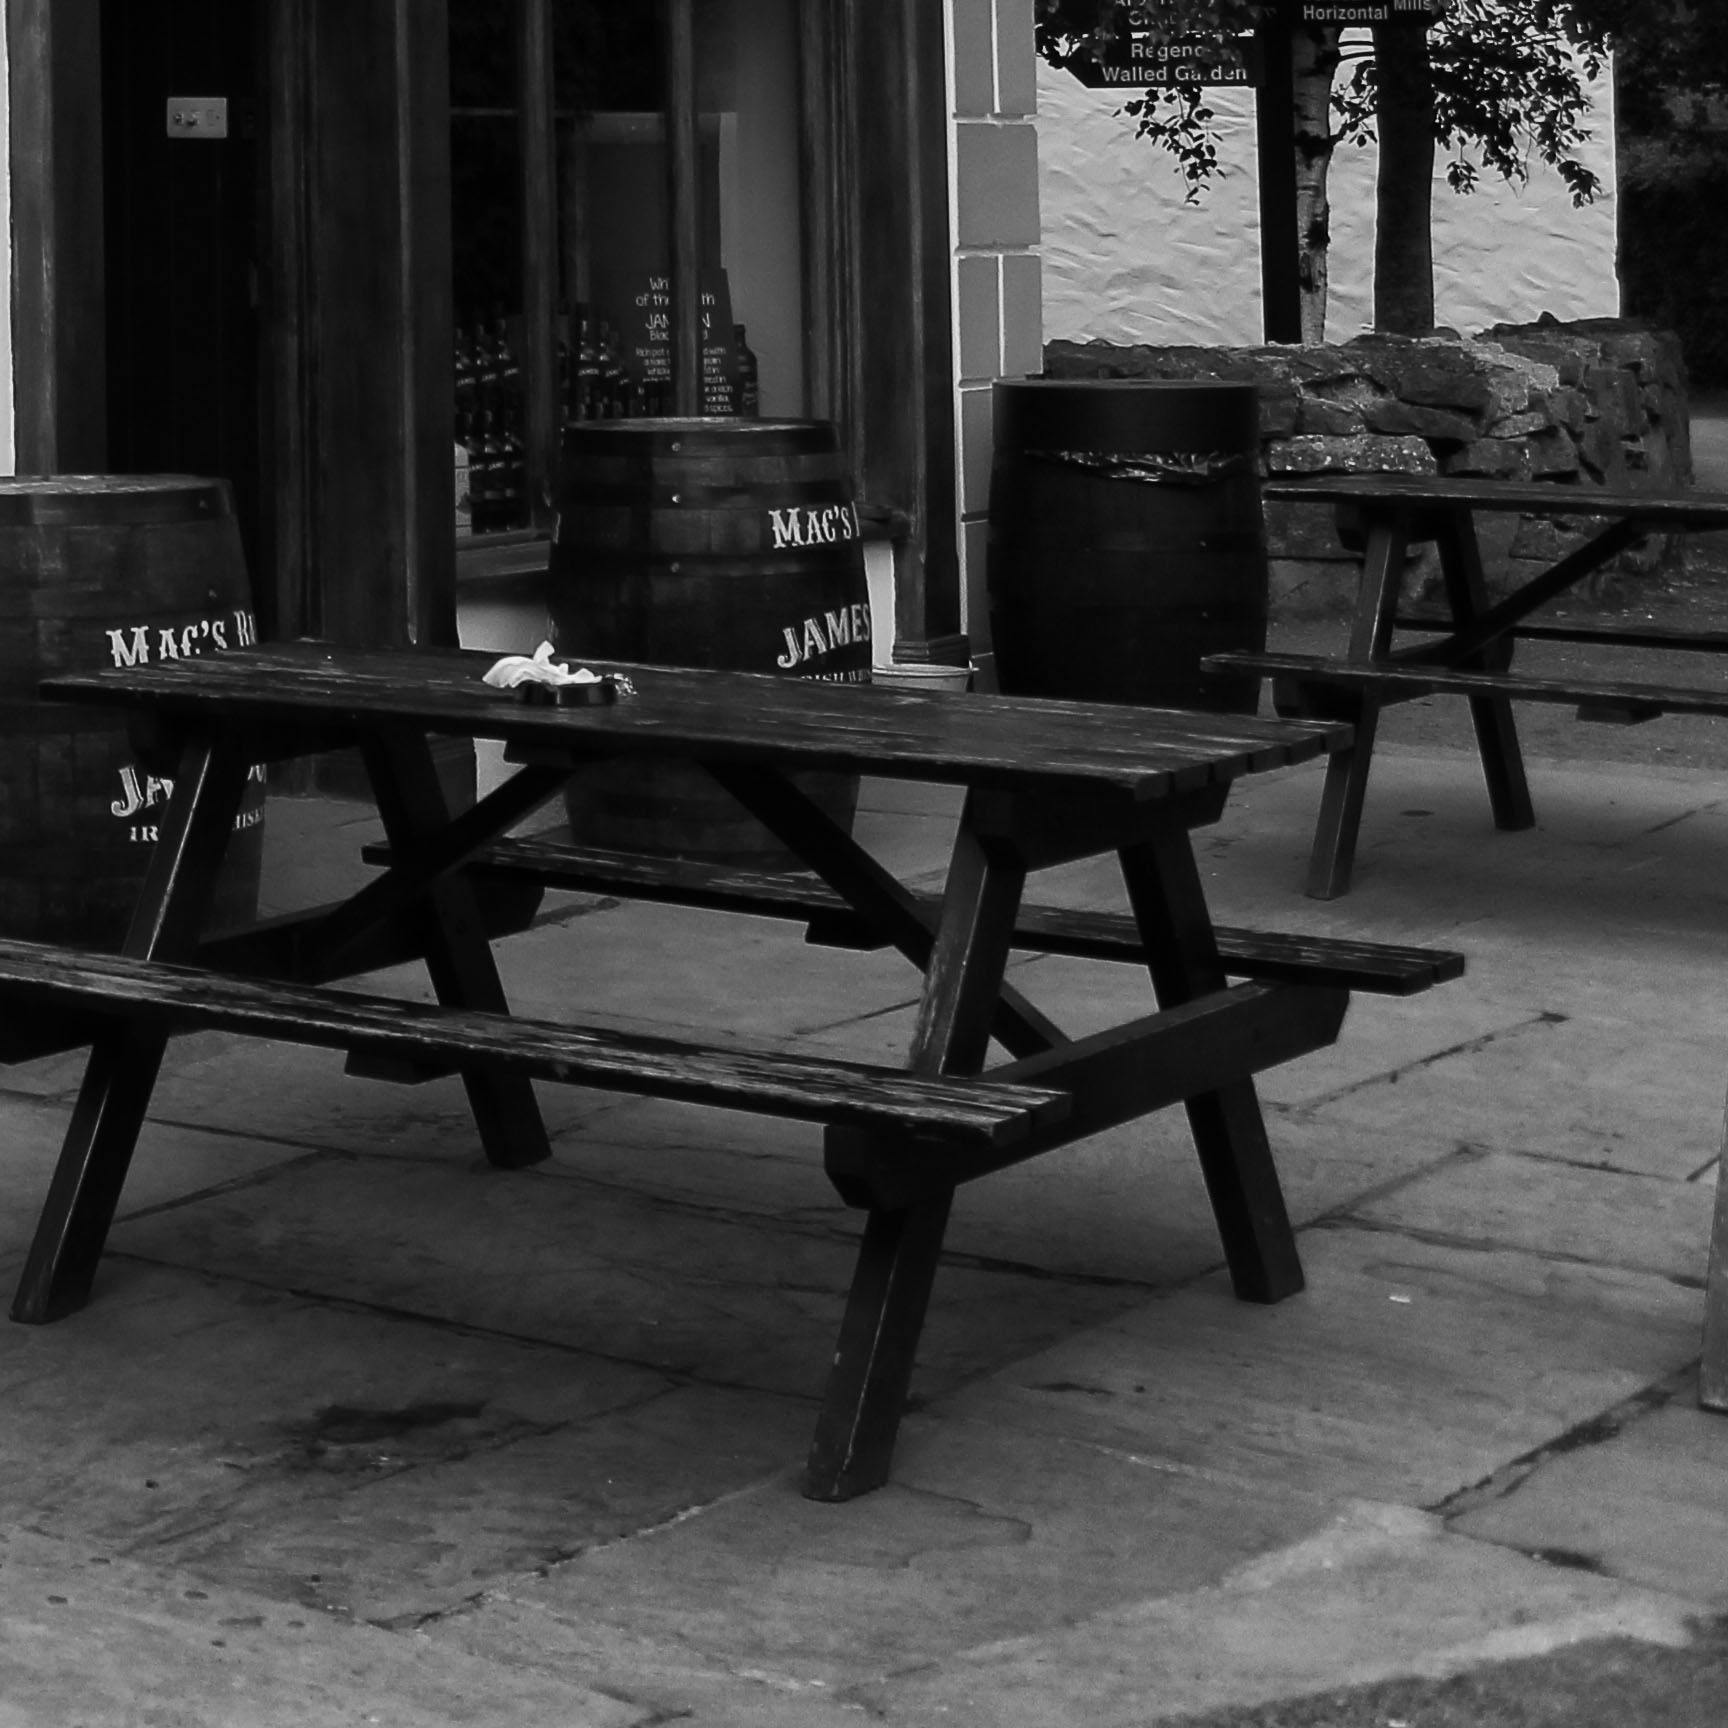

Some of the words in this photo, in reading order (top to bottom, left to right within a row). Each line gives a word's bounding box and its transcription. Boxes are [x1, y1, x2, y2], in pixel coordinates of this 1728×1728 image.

[1303, 4, 1389, 20] Horizontal
[1131, 42, 1205, 62] Regenc
[1102, 65, 1167, 82] Walled
[1175, 65, 1247, 81] Gaden
[767, 504, 852, 549] MAC'S
[105, 619, 229, 667] MAC'S
